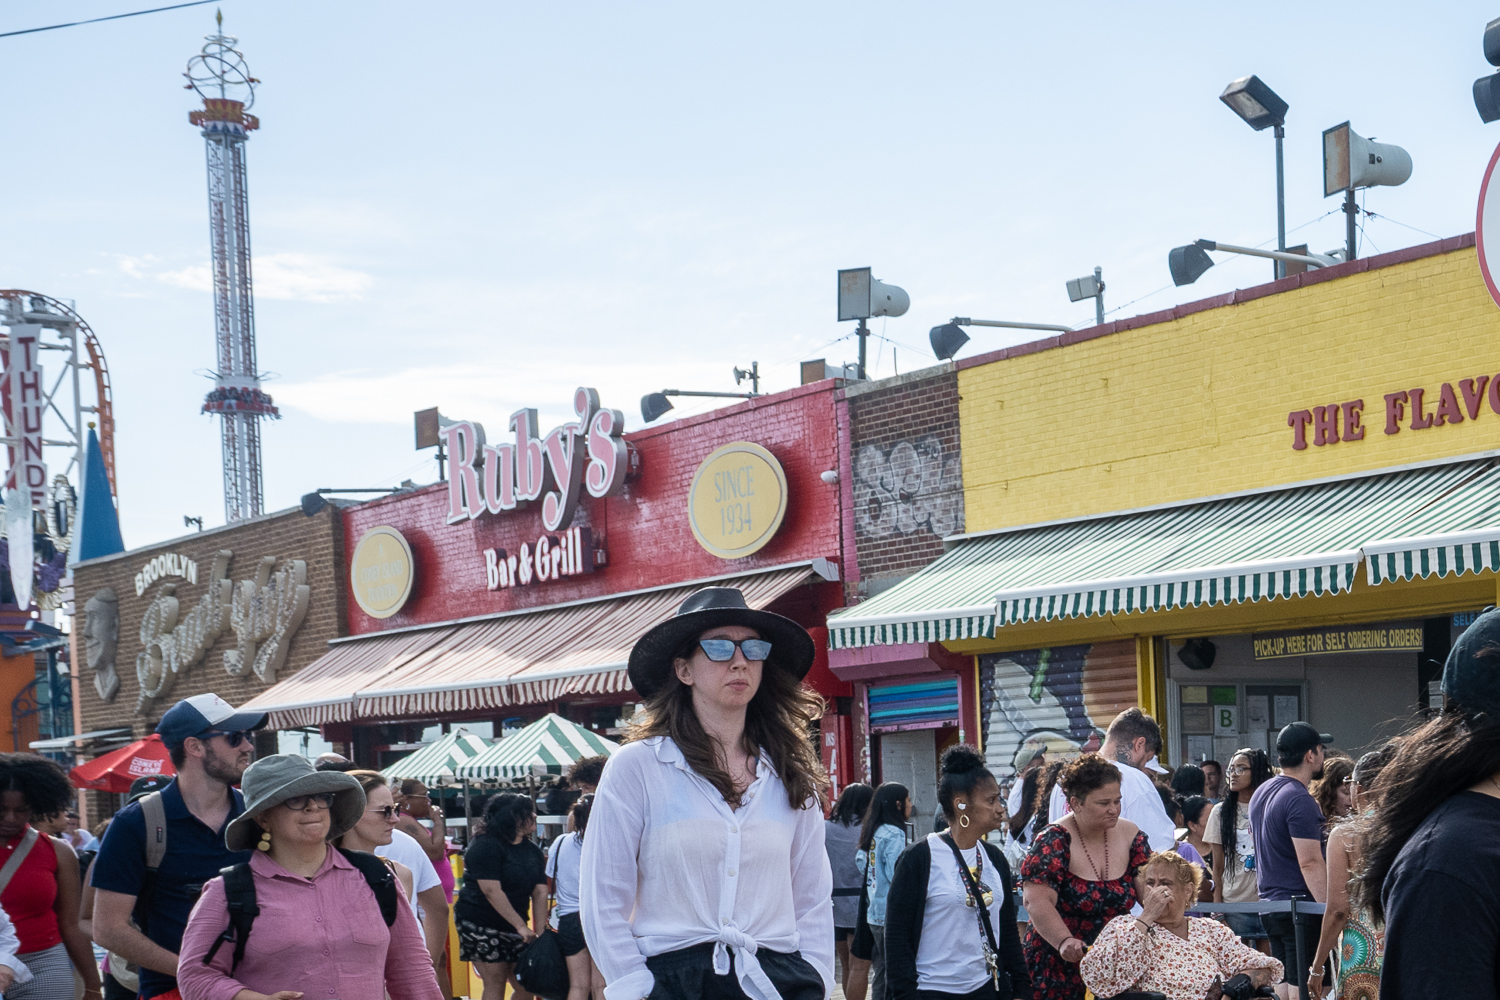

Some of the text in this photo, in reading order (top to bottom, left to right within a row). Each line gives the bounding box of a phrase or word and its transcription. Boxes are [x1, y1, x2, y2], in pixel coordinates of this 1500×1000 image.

[1288, 401, 1365, 451] THE
[440, 387, 622, 531] Ruby's
[714, 466, 756, 503] SINCE
[719, 503, 753, 536] 1934
[134, 553, 199, 597] BROOKLYN
[1254, 628, 1423, 657] PICK-UP HERE FOR SELF ORDERING ORDERS!
[1220, 709, 1232, 727] B
